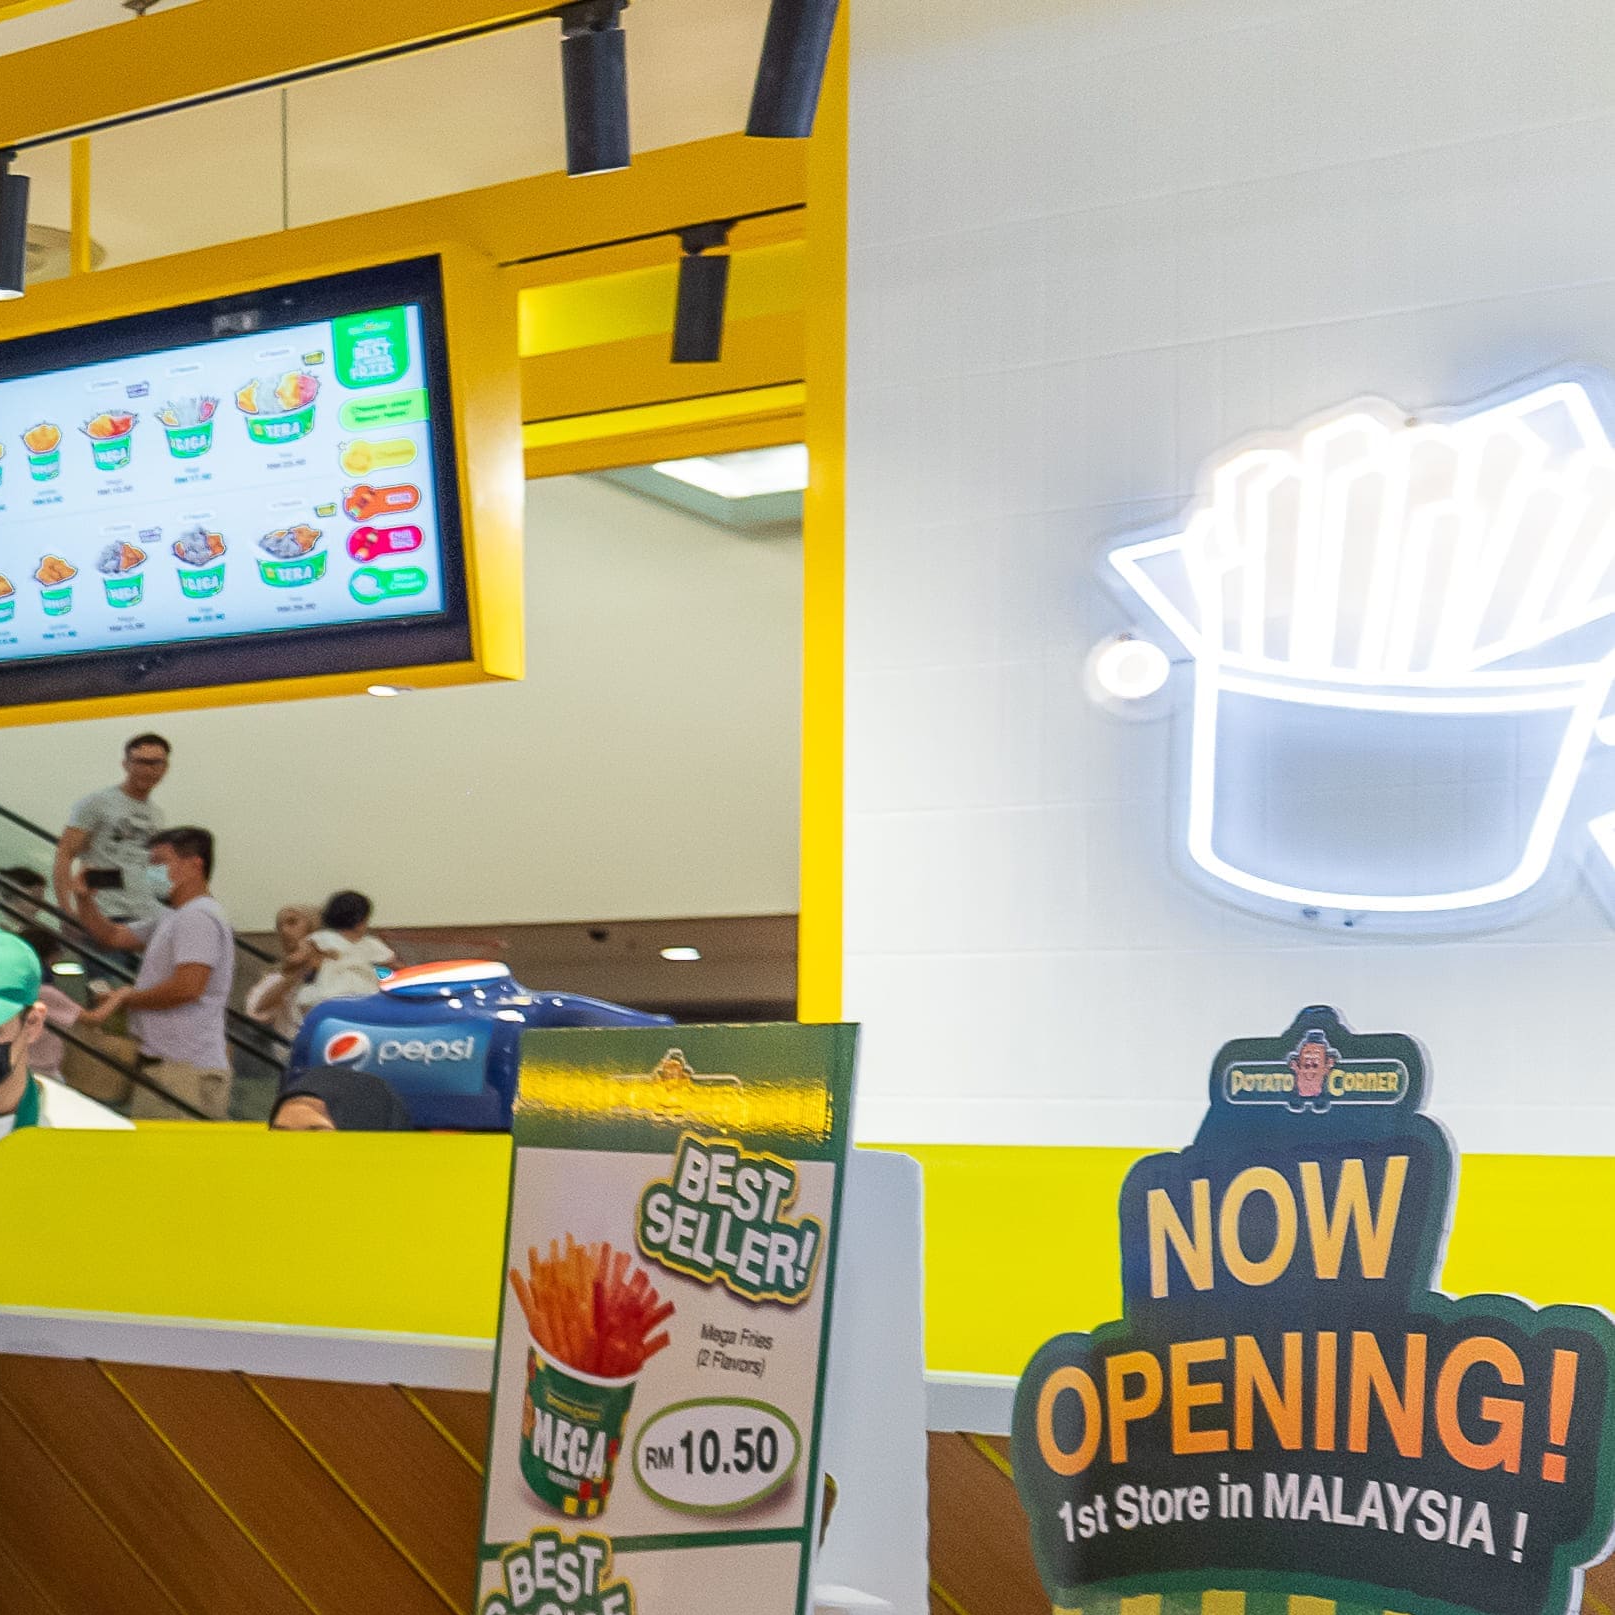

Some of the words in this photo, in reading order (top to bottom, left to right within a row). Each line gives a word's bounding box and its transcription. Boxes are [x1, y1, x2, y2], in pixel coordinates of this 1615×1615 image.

[378, 1036, 475, 1064] pepsi
[1231, 1070, 1295, 1096] POTATO
[1328, 1069, 1399, 1097] CORNER
[678, 1146, 791, 1224] BEST
[645, 1190, 816, 1290] SELLER!
[1147, 1155, 1409, 1299] NOW
[701, 1324, 736, 1348] Mega
[740, 1328, 773, 1350] Fries
[533, 1407, 607, 1479] MEGA
[1036, 1330, 1580, 1484] OPENING!
[645, 1443, 674, 1470] RM
[680, 1427, 779, 1475] 10.50
[1057, 1499, 1109, 1543] 1st
[1115, 1482, 1210, 1530] Store
[1218, 1472, 1254, 1519] in
[1264, 1471, 1497, 1557] MALAYSIA
[507, 1540, 602, 1607] BEST
